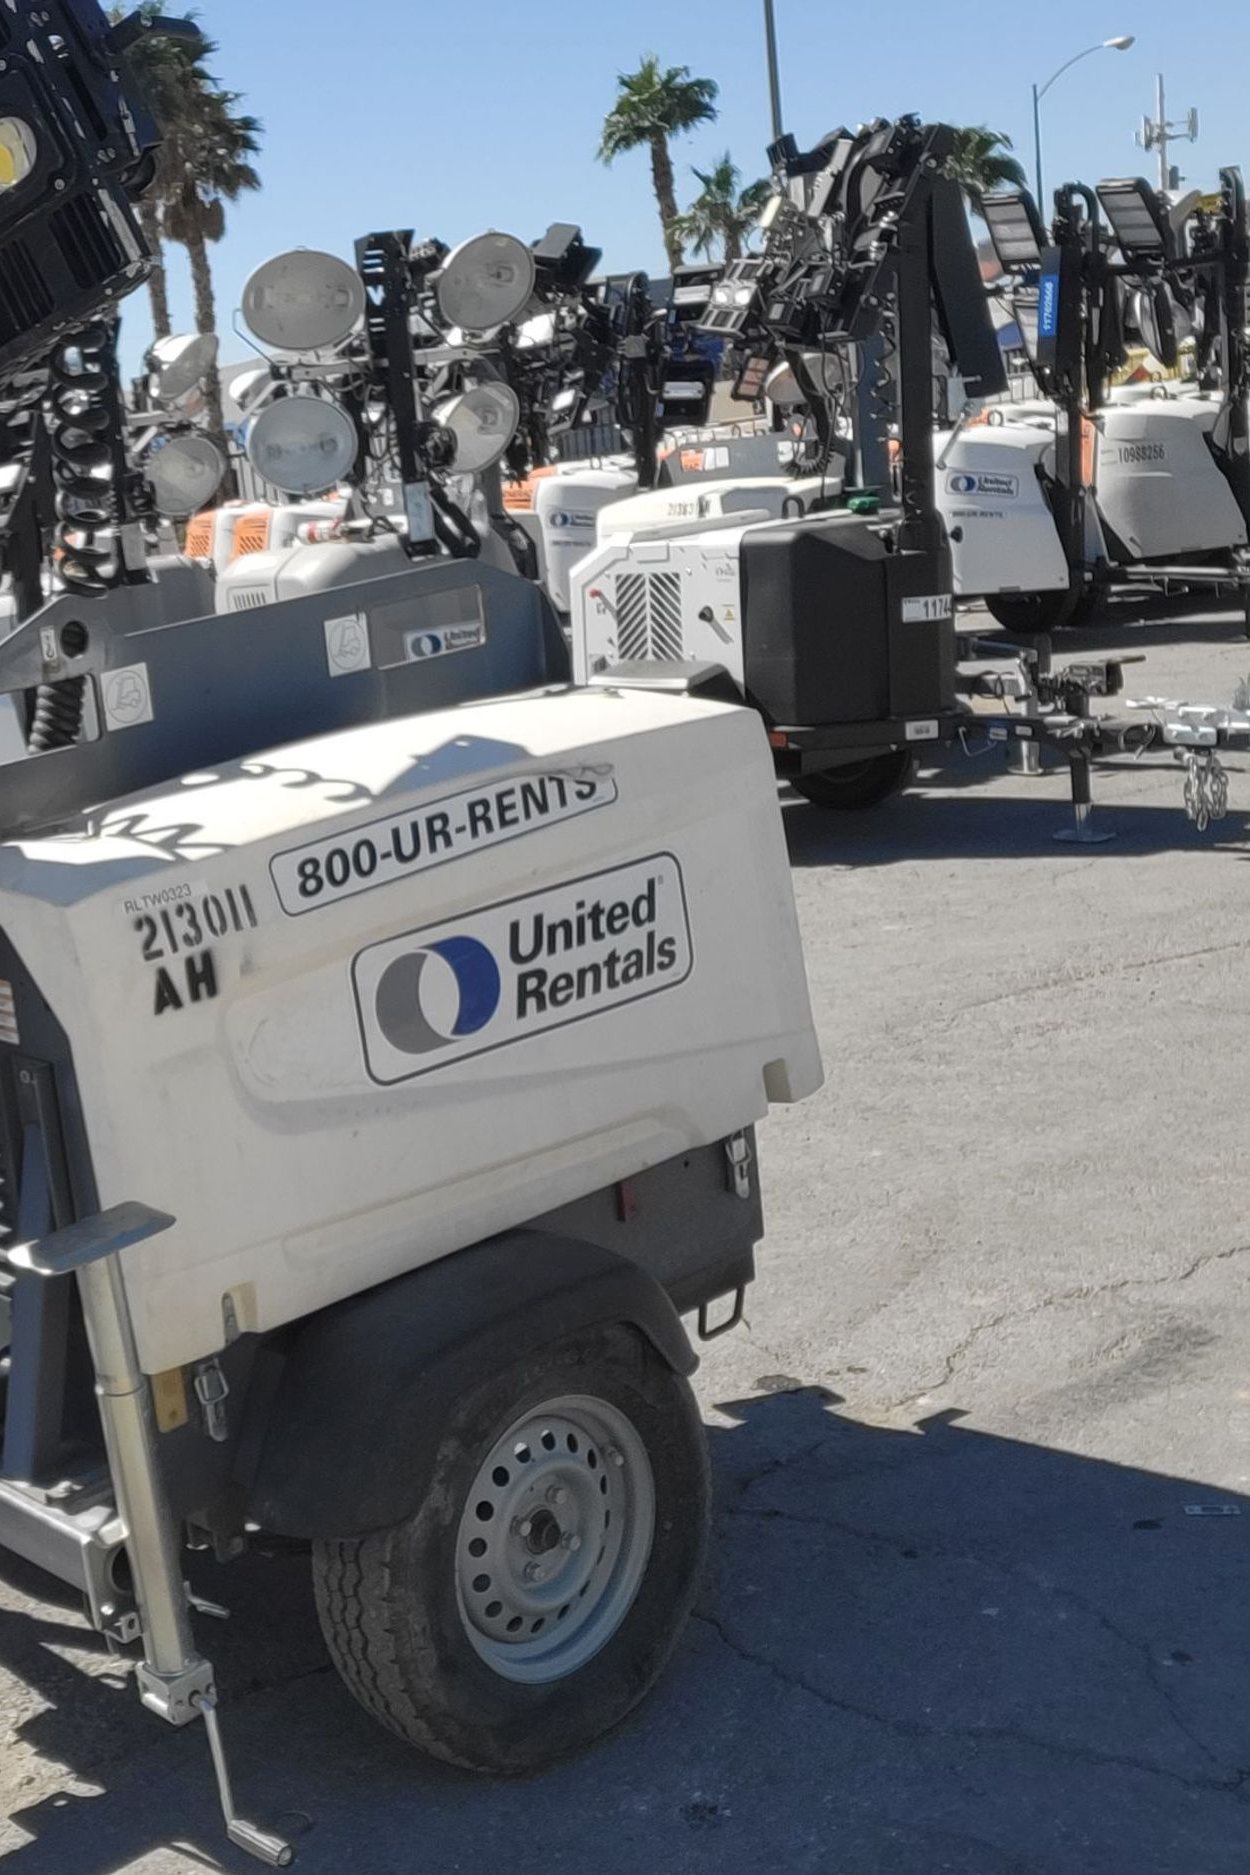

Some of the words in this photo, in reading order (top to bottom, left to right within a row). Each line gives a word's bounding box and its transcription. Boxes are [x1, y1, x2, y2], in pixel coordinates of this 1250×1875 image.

[297, 775, 598, 898] 800-UR-RENTS
[124, 883, 192, 914] RLTW0323
[134, 884, 258, 961] 213011
[509, 877, 656, 965] United
[154, 948, 219, 1015] AH
[517, 930, 676, 1020] Rentals
